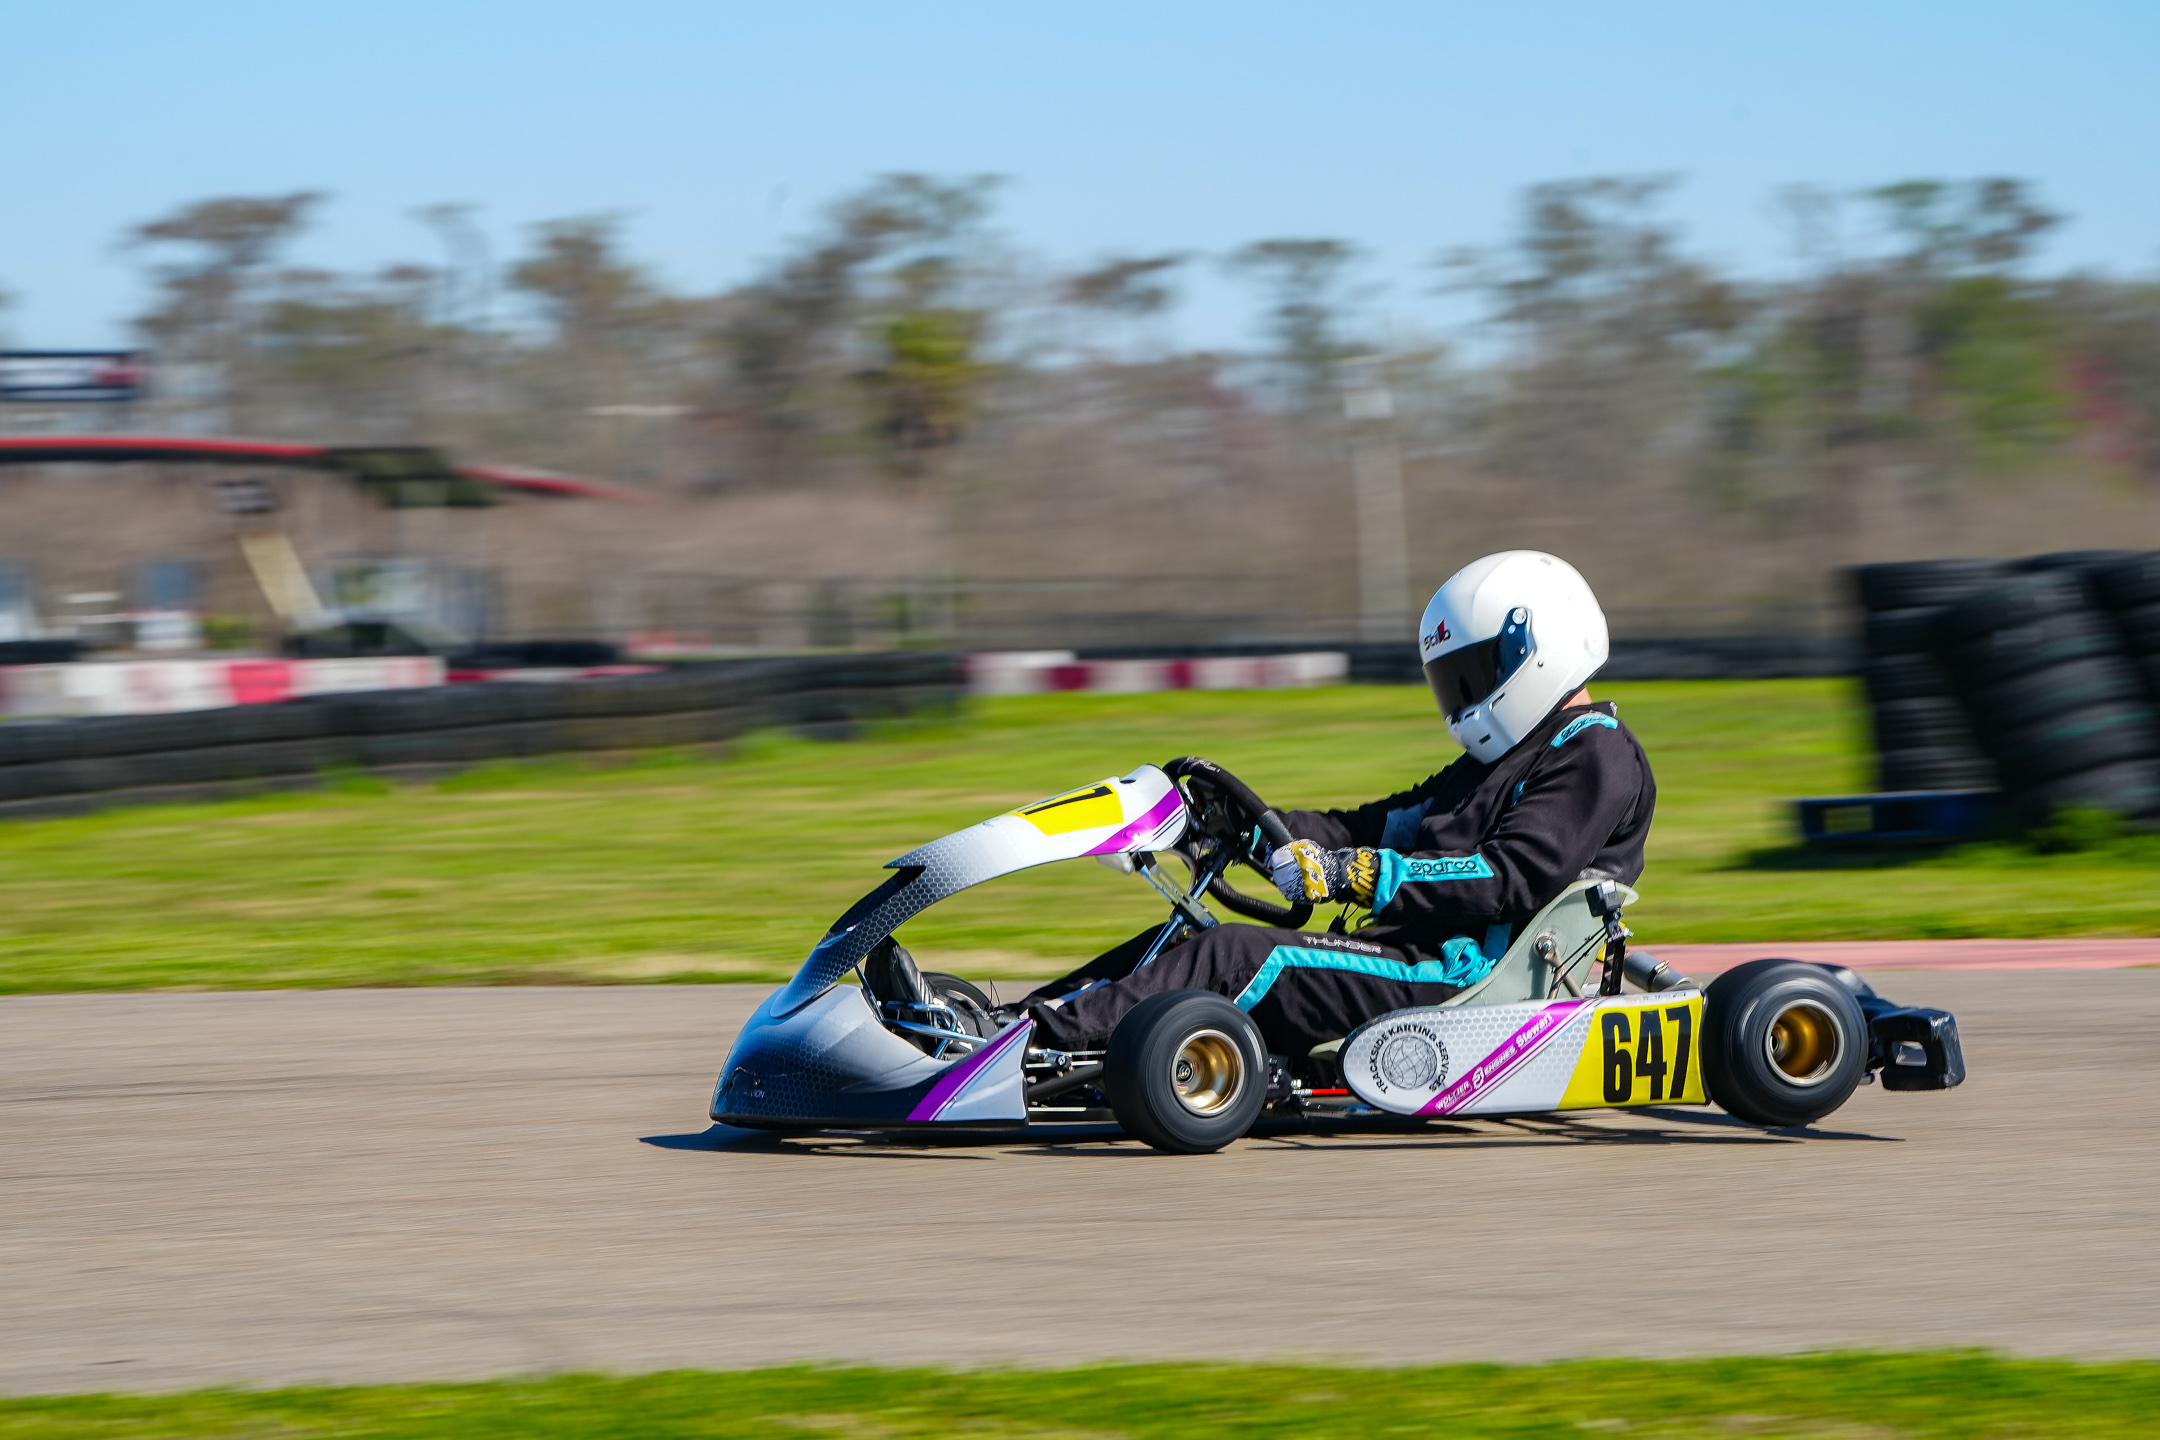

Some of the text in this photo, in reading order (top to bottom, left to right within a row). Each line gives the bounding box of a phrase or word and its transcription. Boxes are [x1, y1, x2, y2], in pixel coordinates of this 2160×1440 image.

[1409, 860, 1478, 877] sparco
[1369, 1032, 1389, 1094] TRACKSIDE
[1388, 1023, 1437, 1042] KARTING
[1428, 1040, 1449, 1092] SERVICES
[1602, 1005, 1691, 1103] 647
